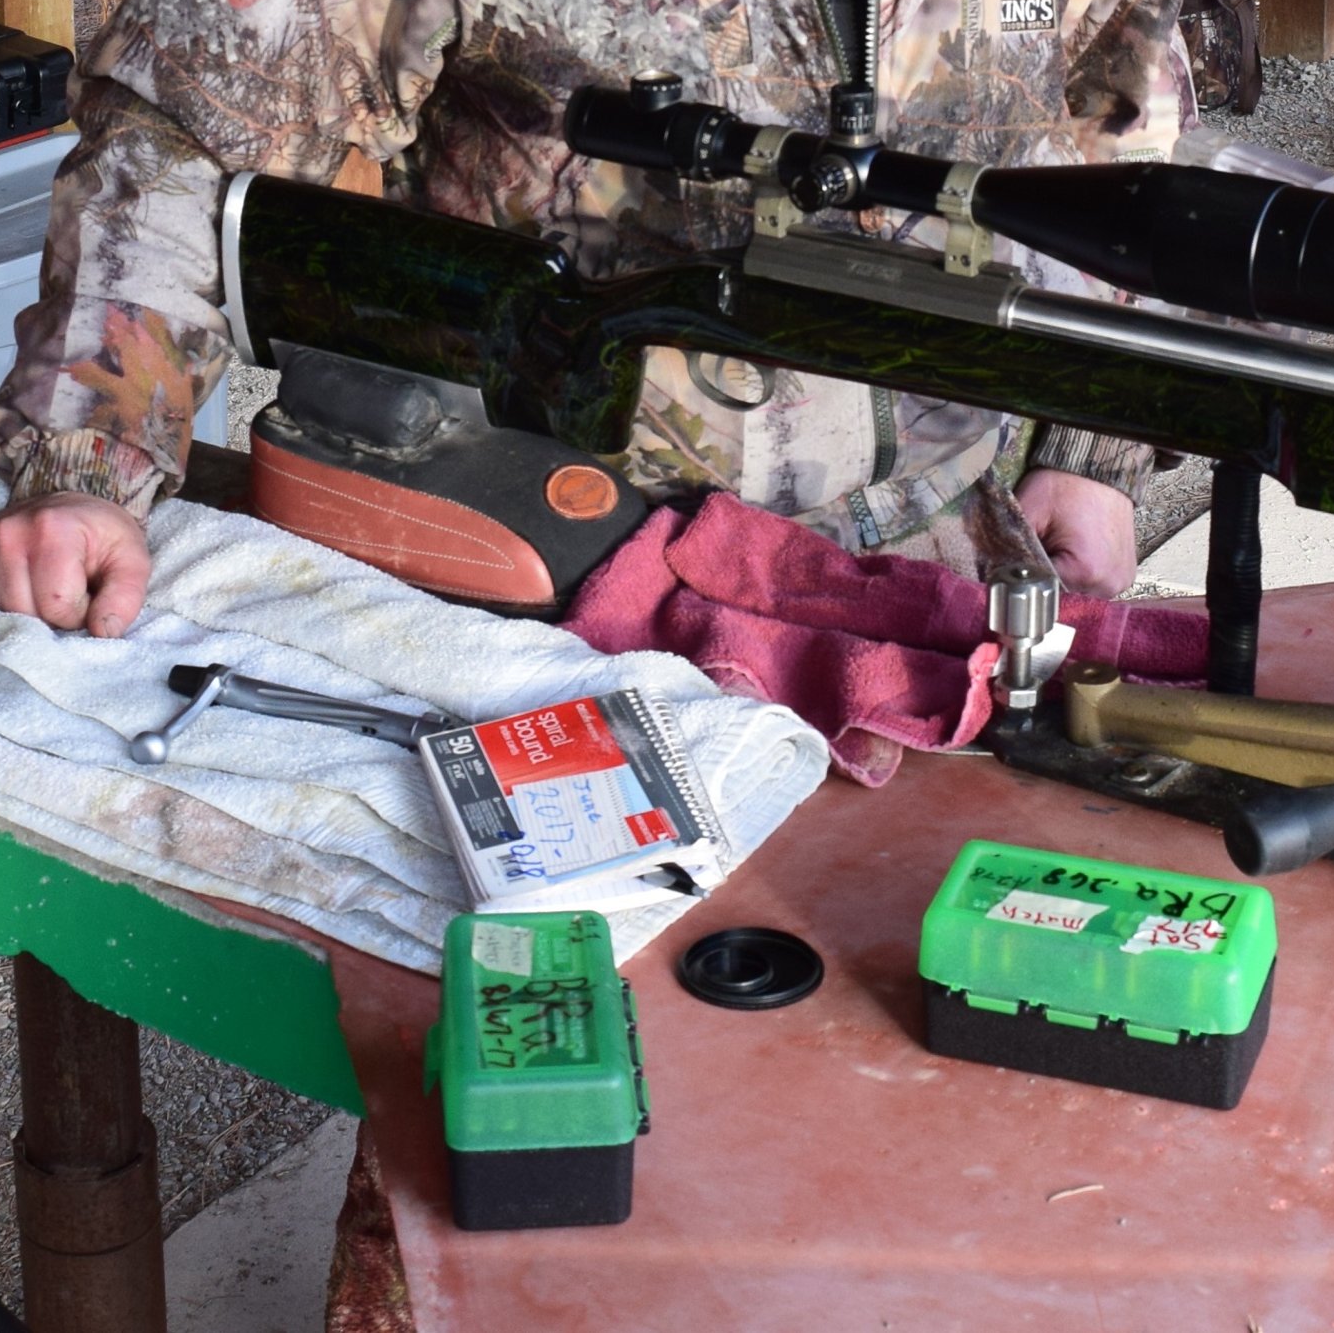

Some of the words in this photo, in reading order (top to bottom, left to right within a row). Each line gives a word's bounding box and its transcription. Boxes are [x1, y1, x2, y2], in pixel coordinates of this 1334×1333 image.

[511, 715, 554, 765] bound
[538, 710, 574, 748] spiral
[446, 734, 475, 756] 50
[1149, 929, 1201, 950] Sat
